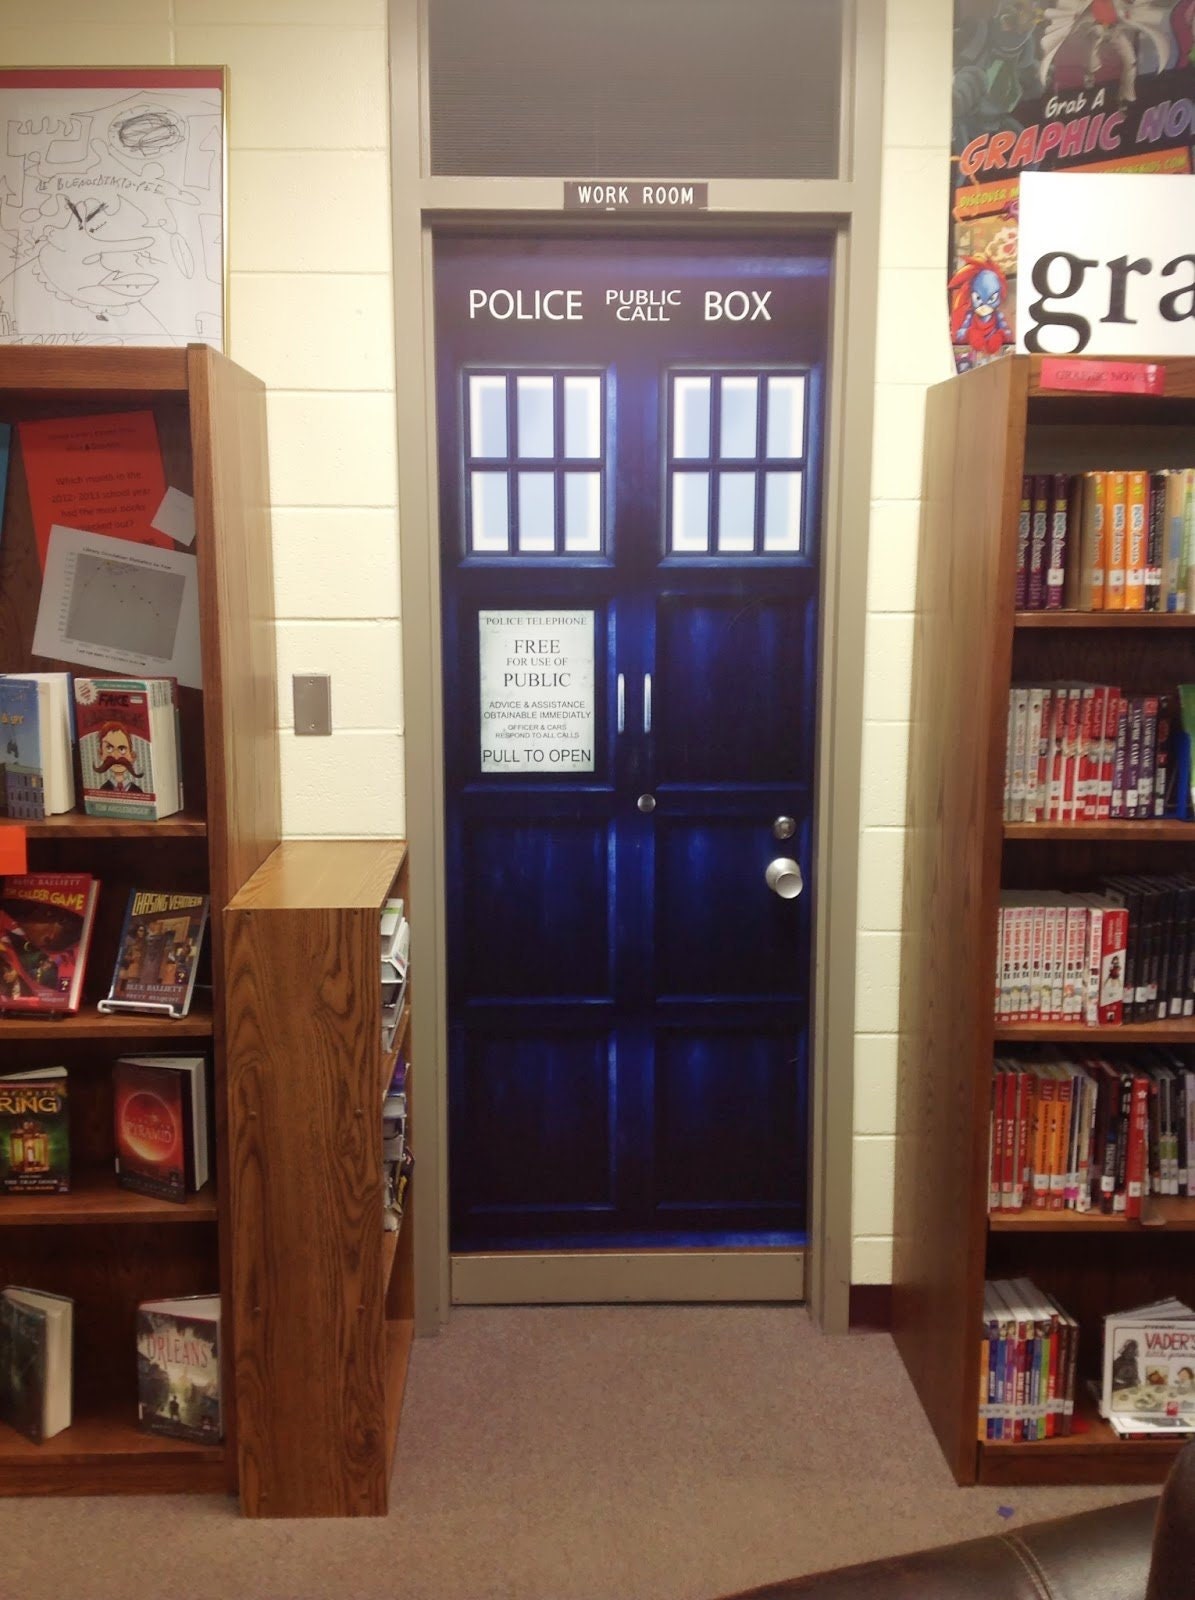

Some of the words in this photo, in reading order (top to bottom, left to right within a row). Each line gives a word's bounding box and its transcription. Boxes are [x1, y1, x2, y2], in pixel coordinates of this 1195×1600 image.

[1045, 92, 1086, 119] Grab
[1091, 88, 1105, 110] A
[960, 110, 1126, 176] GRAPHIC
[578, 186, 629, 204] WORK
[643, 187, 694, 204] ROOM
[959, 188, 1007, 208] DISCOVER
[469, 289, 583, 320] POLICE
[606, 290, 681, 305] PUBLIC
[616, 306, 670, 321] CALL
[704, 291, 772, 321] BOX
[486, 617, 523, 626] POLICE
[527, 617, 587, 626] TELEPHONE
[514, 640, 561, 654] FREE
[506, 657, 528, 666] FOR
[530, 657, 552, 666] USE
[554, 657, 568, 666] OF
[504, 673, 571, 687] PUBLIC
[100, 693, 129, 708] FAKE
[489, 701, 521, 709] ADVICE
[523, 701, 530, 709] &
[531, 701, 585, 709] ASSISTANCE
[483, 711, 537, 719] OBTAINABLE
[483, 750, 521, 762] PULL
[524, 750, 545, 762] TO
[549, 750, 591, 762] OPEN
[50, 892, 84, 910] GAME
[132, 892, 169, 916] CHASING
[147, 1333, 209, 1370] ORLEANS
